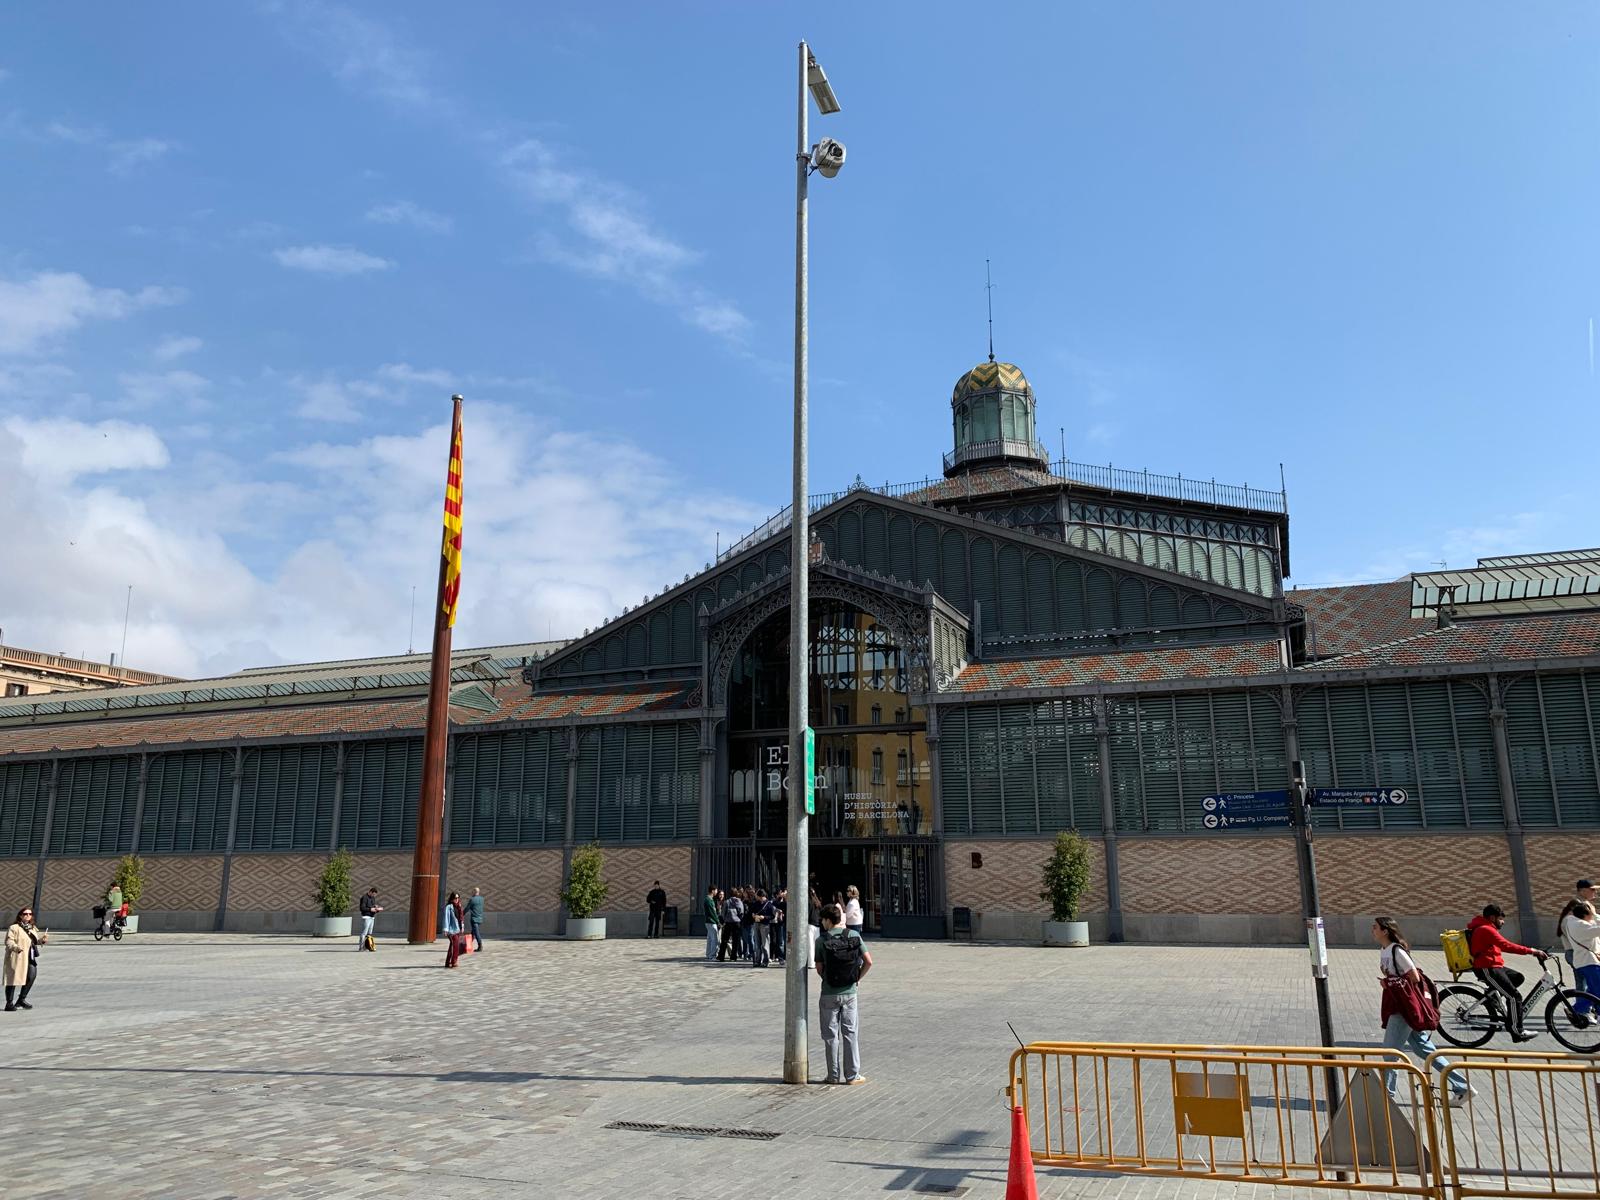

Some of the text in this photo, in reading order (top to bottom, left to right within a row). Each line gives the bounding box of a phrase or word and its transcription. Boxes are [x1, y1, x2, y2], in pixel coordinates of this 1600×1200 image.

[844, 792, 872, 800] MUSEU
[844, 810, 910, 820] DE BARCELONA
[1526, 985, 1545, 1008] zoomo
